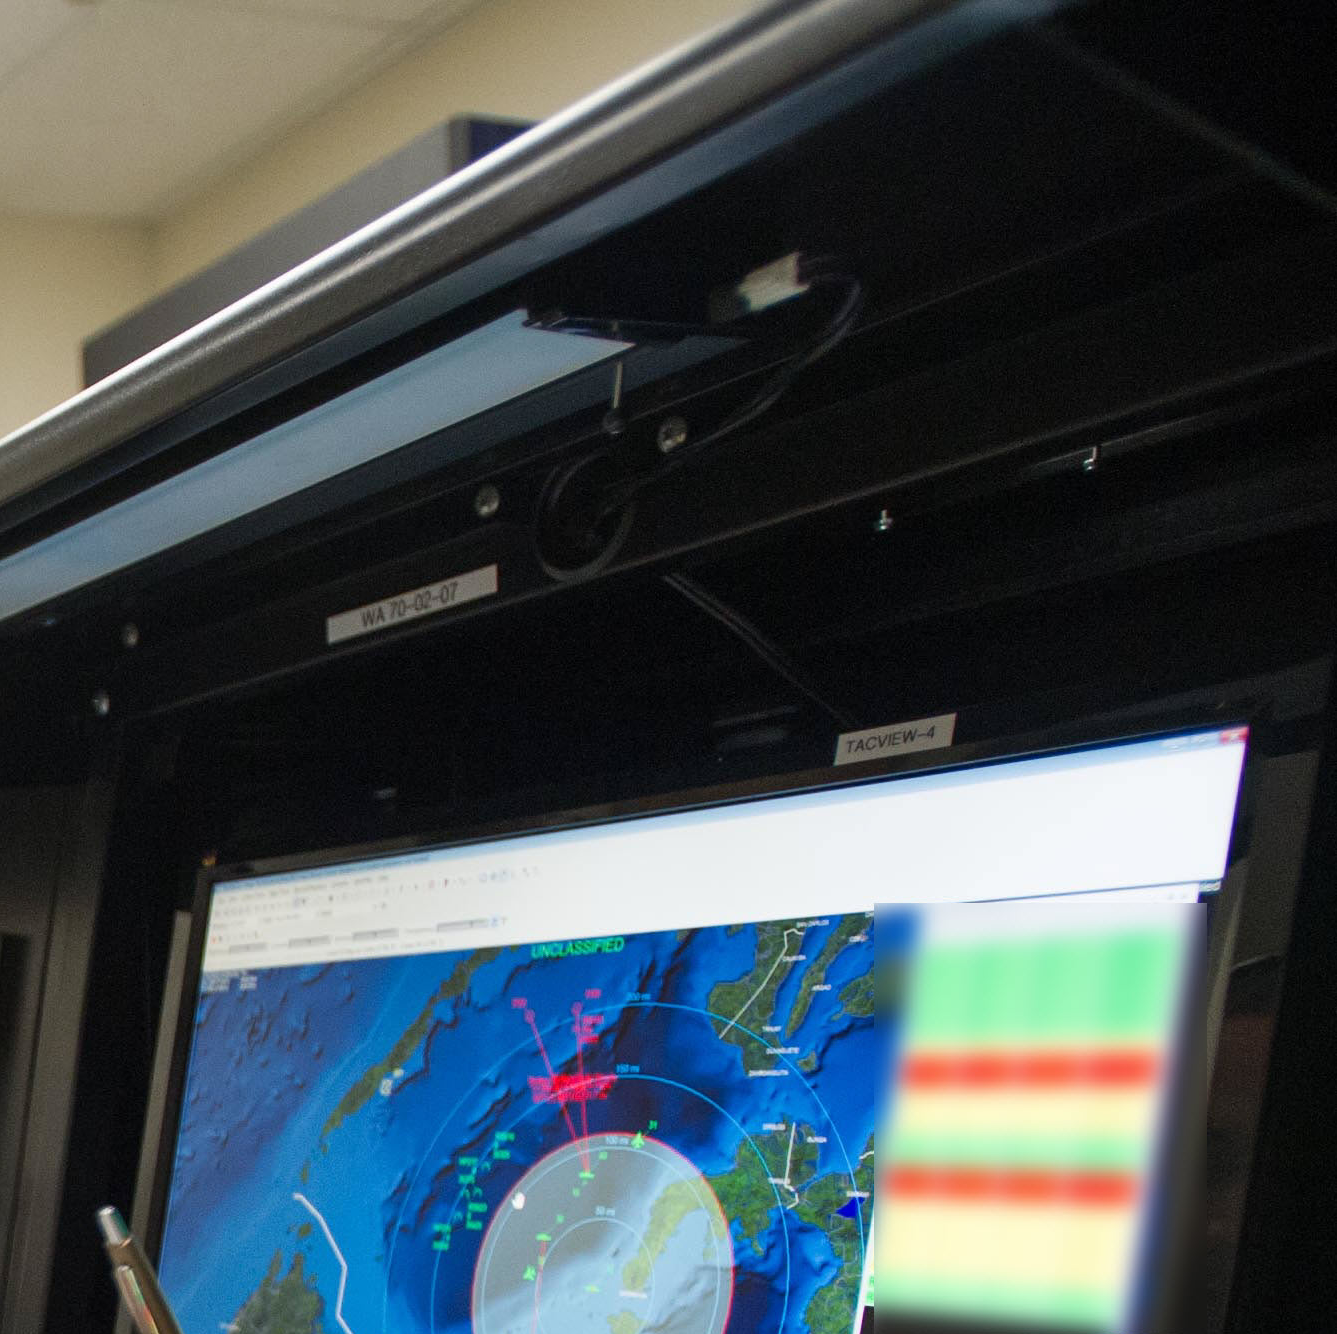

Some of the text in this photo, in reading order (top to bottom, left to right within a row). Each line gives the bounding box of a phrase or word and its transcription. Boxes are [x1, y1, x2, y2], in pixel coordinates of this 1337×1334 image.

[360, 582, 458, 628] WA 70-02-07
[846, 725, 936, 753] TACVIEW-4
[531, 937, 625, 959] UNCLASSIFIED
